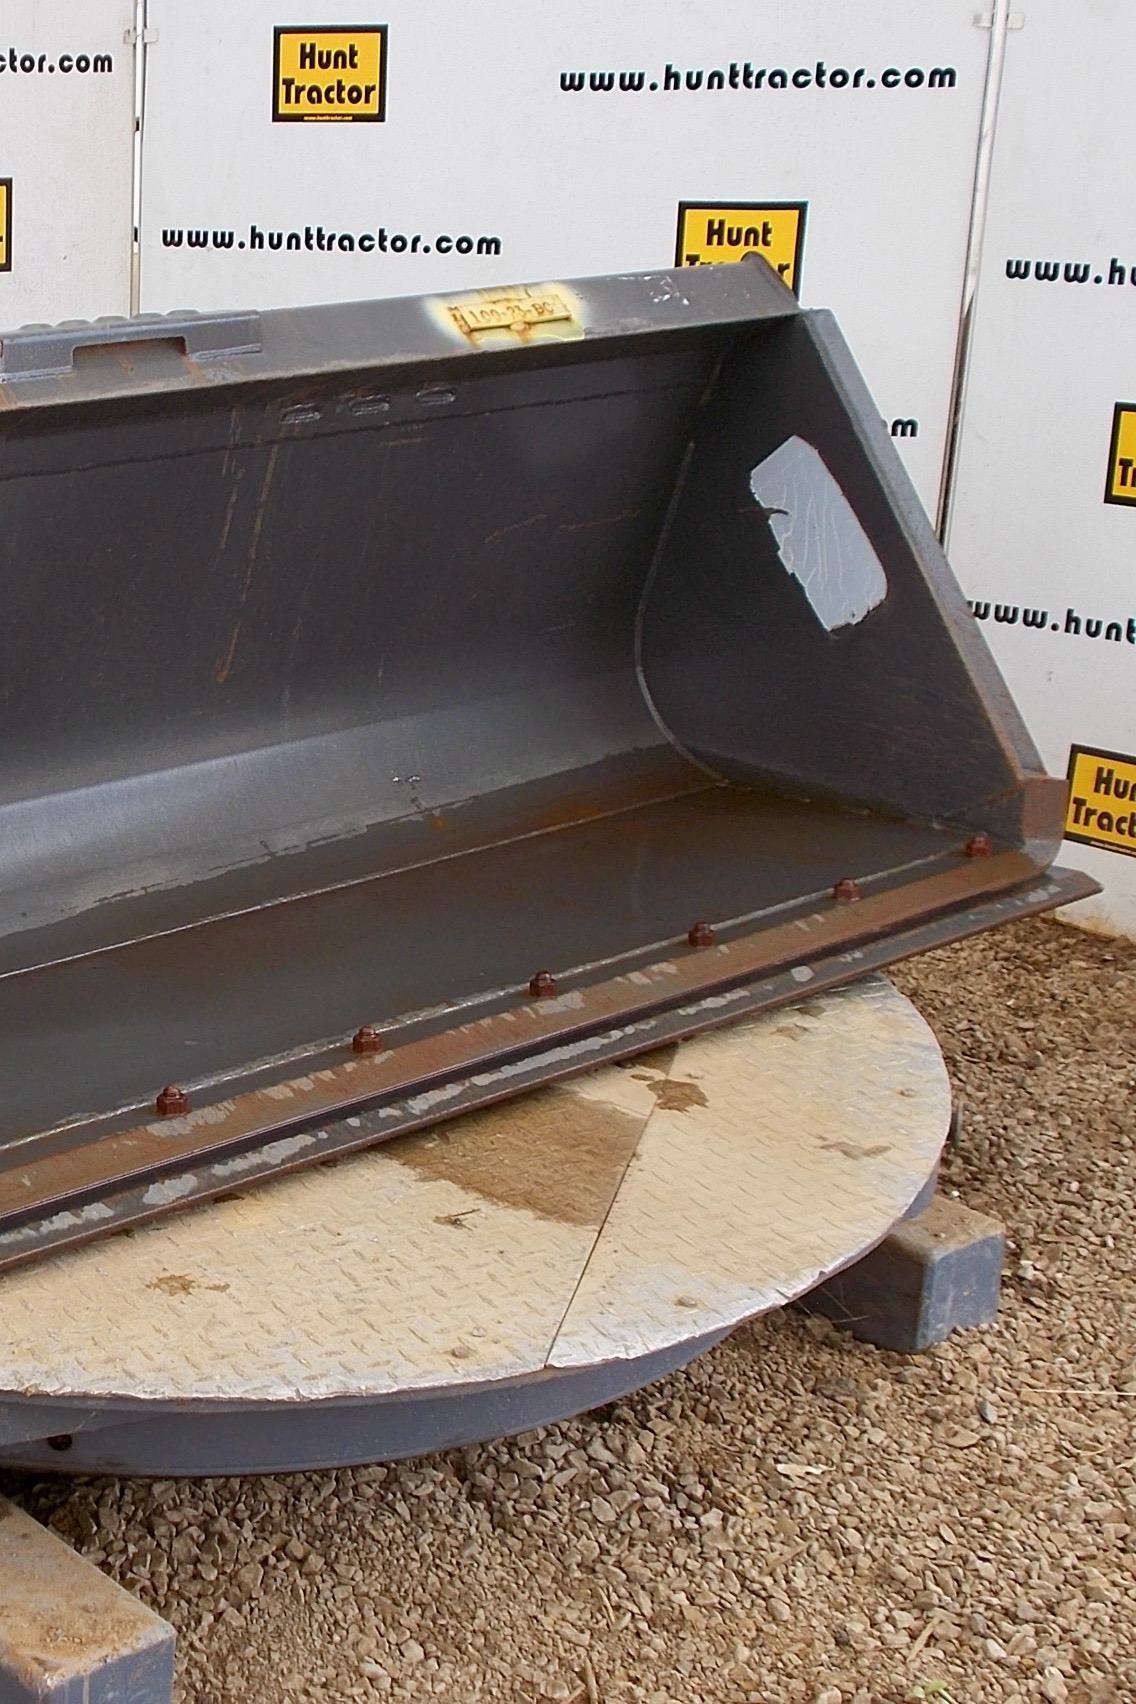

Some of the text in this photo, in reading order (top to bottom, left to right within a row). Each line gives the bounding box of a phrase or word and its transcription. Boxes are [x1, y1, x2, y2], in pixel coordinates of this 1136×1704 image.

[299, 42, 359, 70] Hunt
[281, 77, 377, 105] Tractor
[559, 61, 957, 92] www.hunttractor.com
[162, 225, 501, 256] www.hunttractor.com
[706, 218, 772, 247] Hunt
